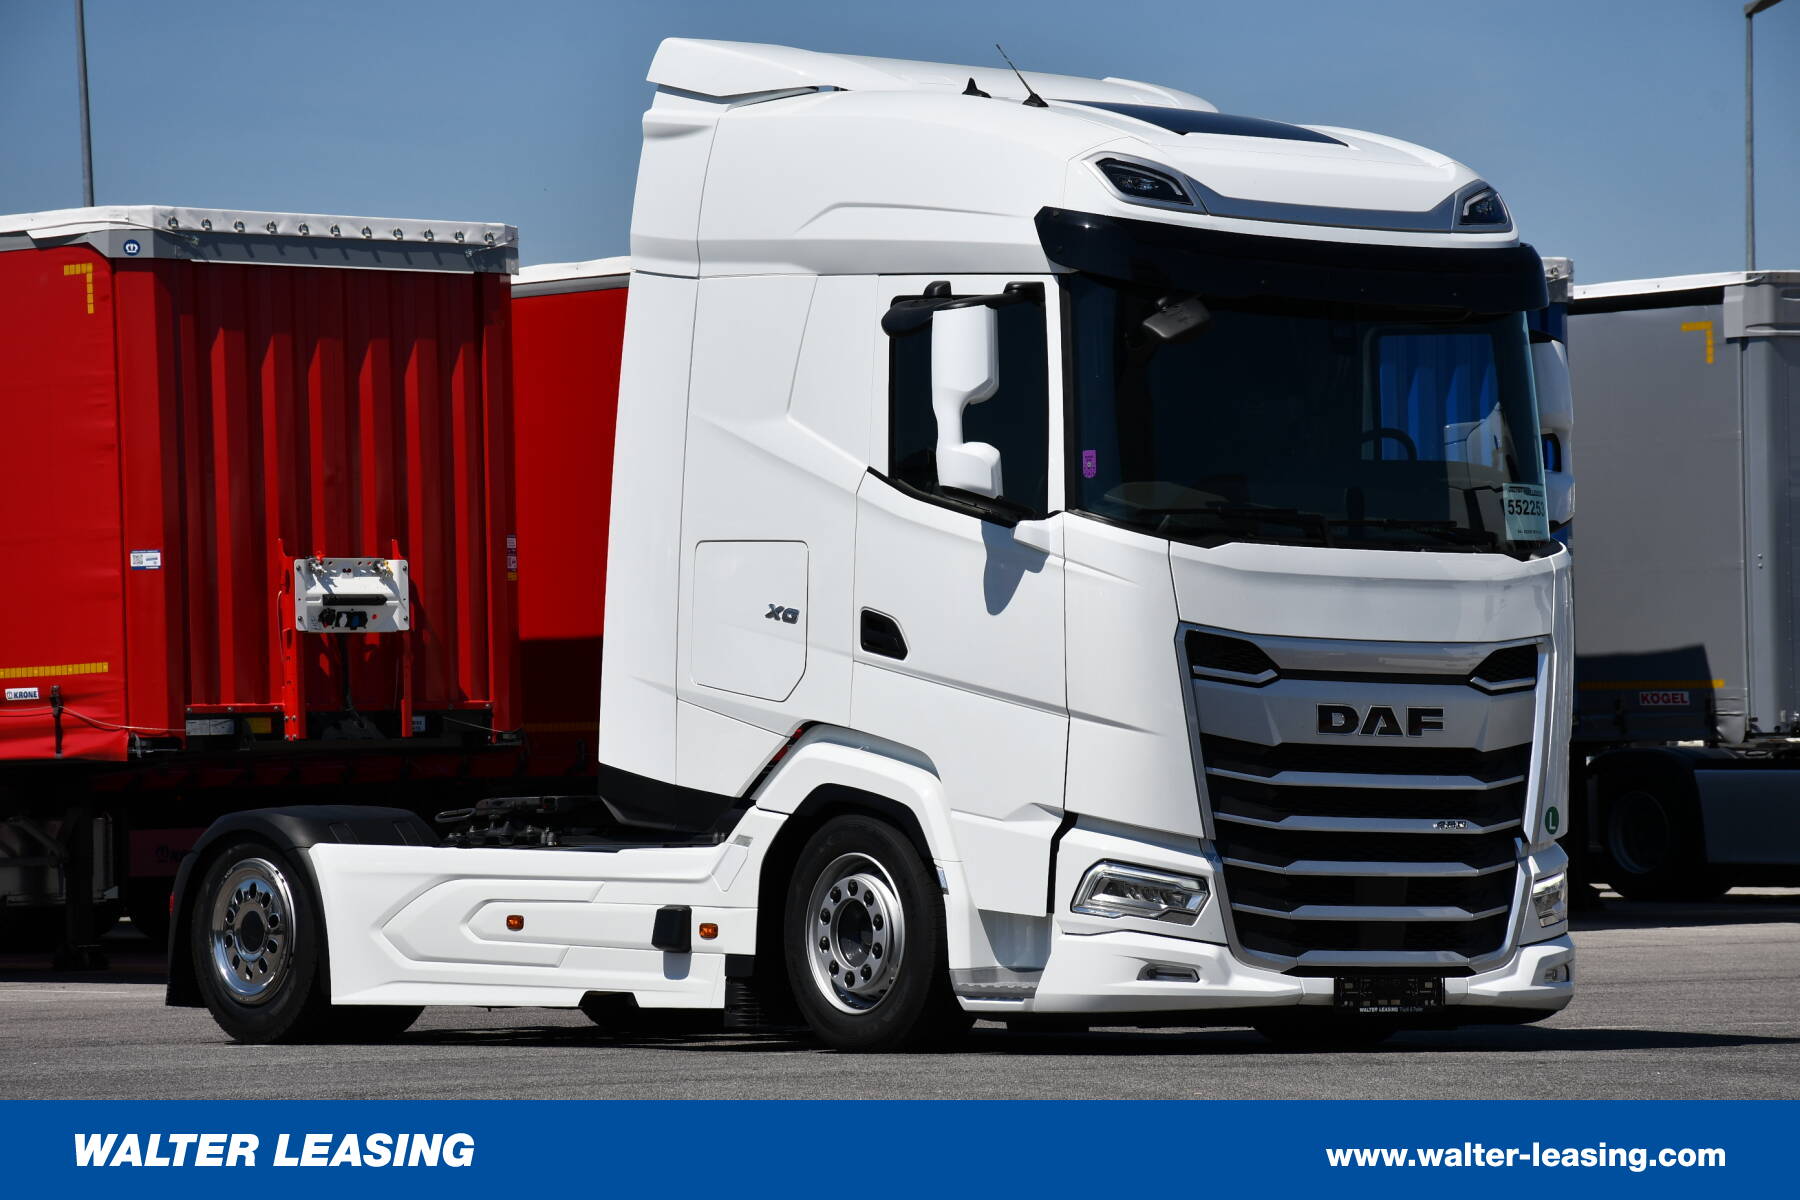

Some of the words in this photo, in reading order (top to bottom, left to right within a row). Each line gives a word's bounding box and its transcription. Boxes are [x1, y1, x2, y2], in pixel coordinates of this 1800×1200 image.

[1507, 499, 1545, 517] 552253
[764, 603, 800, 625] XG
[13, 690, 38, 699] KRONE
[1316, 703, 1444, 737] DAF
[1548, 811, 1557, 830] L
